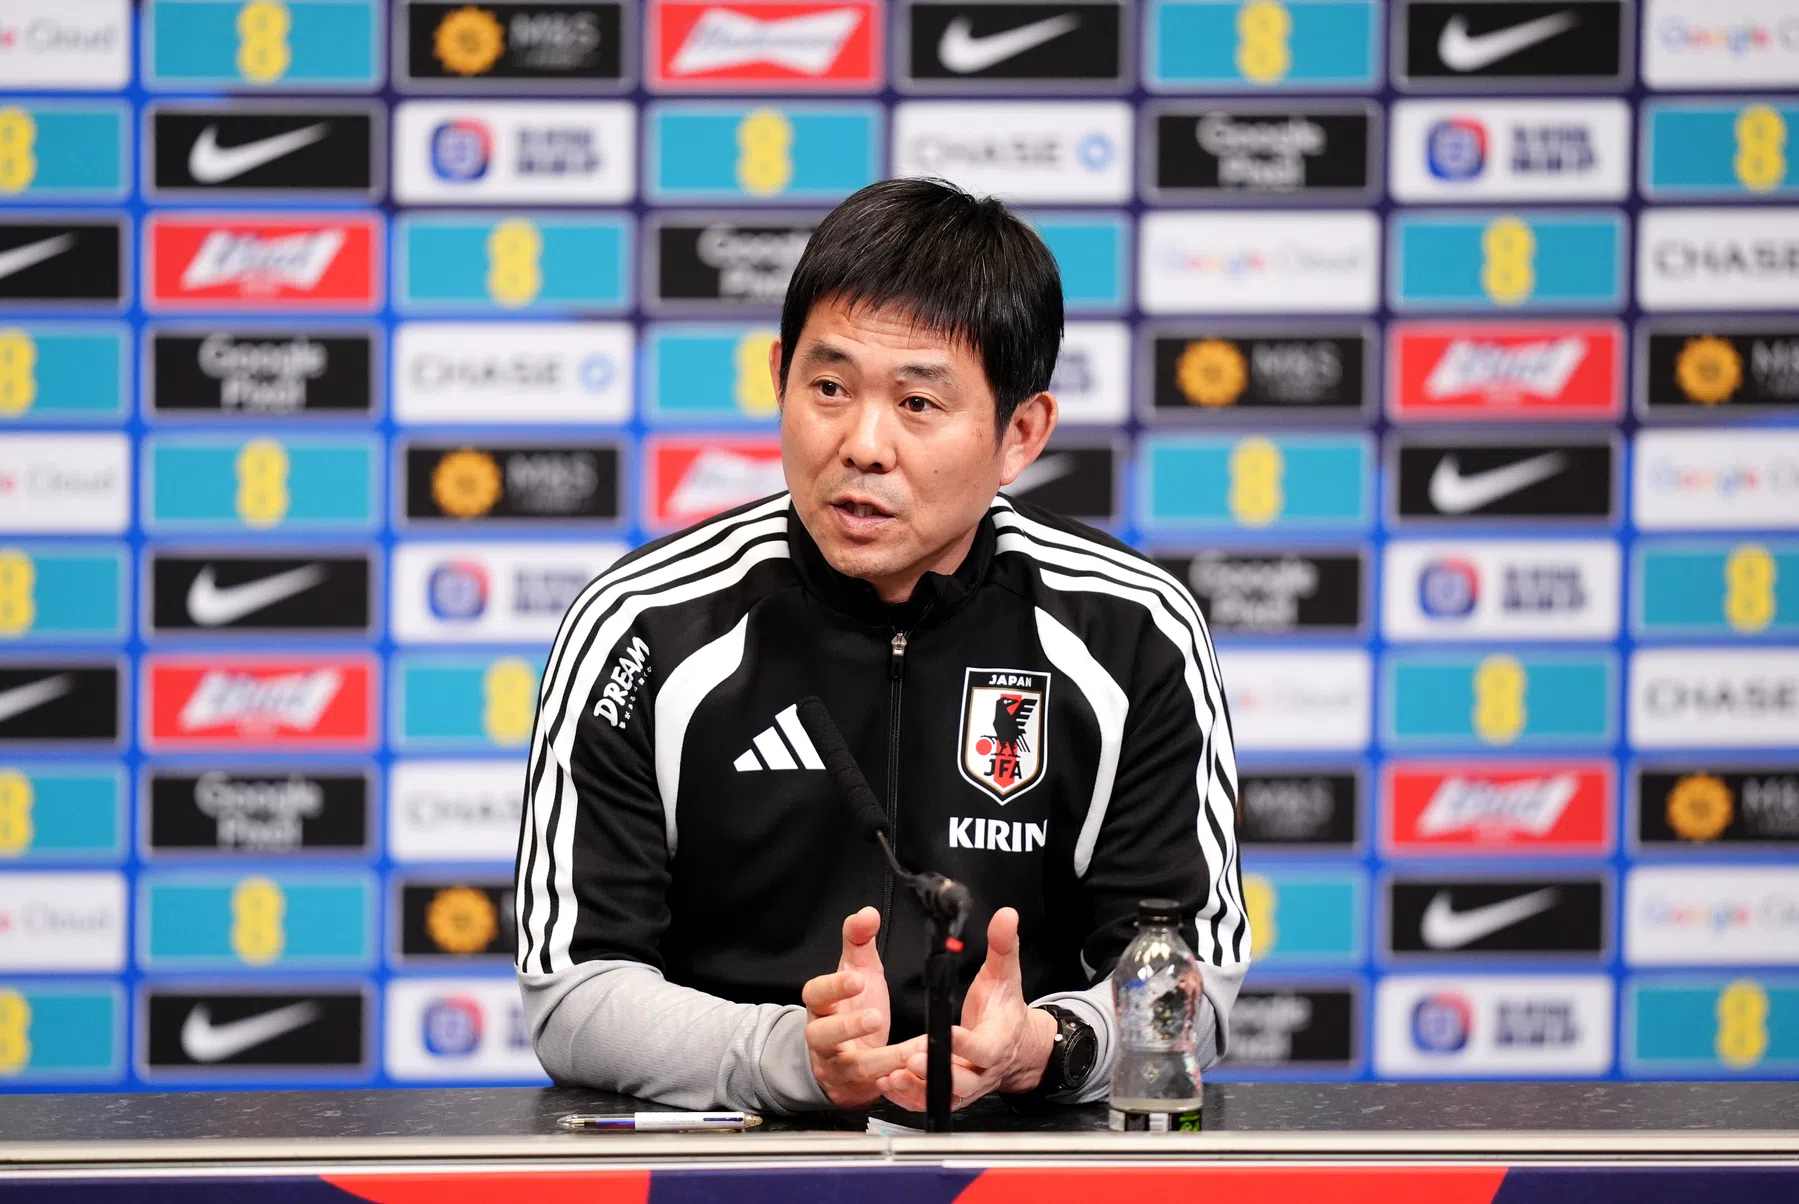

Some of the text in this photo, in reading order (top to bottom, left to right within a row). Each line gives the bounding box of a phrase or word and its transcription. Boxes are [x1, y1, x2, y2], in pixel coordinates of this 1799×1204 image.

[593, 636, 650, 727] DREAM
[989, 674, 1032, 688] JAPAN
[983, 758, 1023, 780] JFA
[949, 817, 1048, 852] KIRIN
